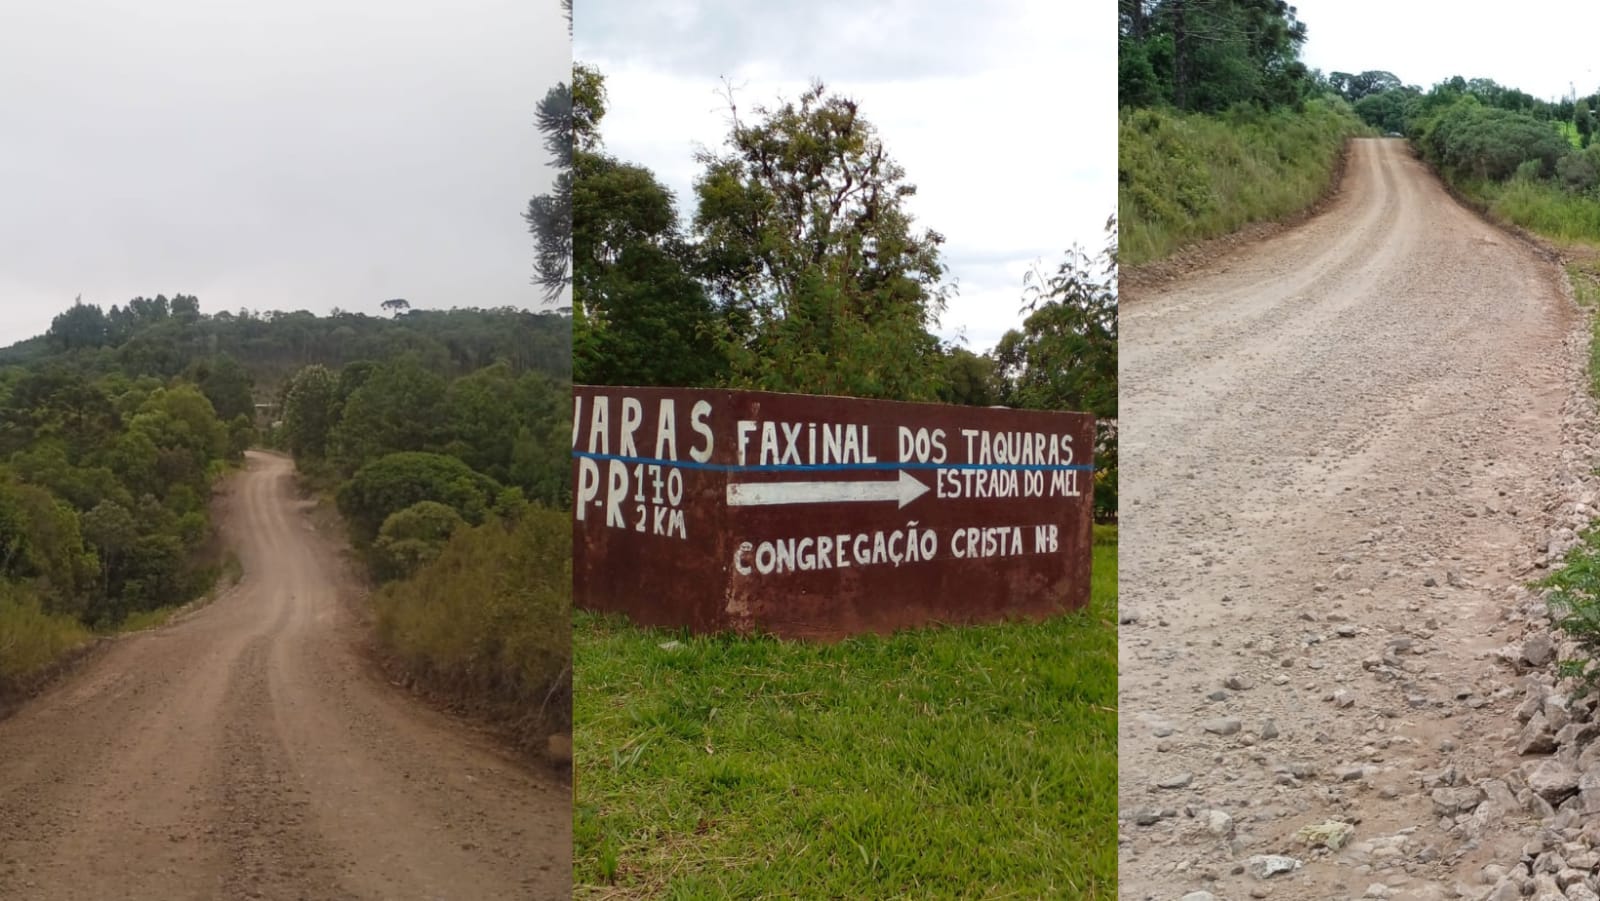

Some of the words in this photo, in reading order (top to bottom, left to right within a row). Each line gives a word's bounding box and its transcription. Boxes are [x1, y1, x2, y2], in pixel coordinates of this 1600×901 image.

[898, 426, 948, 464] DOS
[962, 429, 1074, 465] TAQUARAS
[634, 464, 683, 506] 170
[937, 469, 1019, 498] ESTRADA
[1024, 470, 1044, 497] DO
[1050, 469, 1080, 497] MEL
[734, 520, 938, 576] CONGREGAÇÃO
